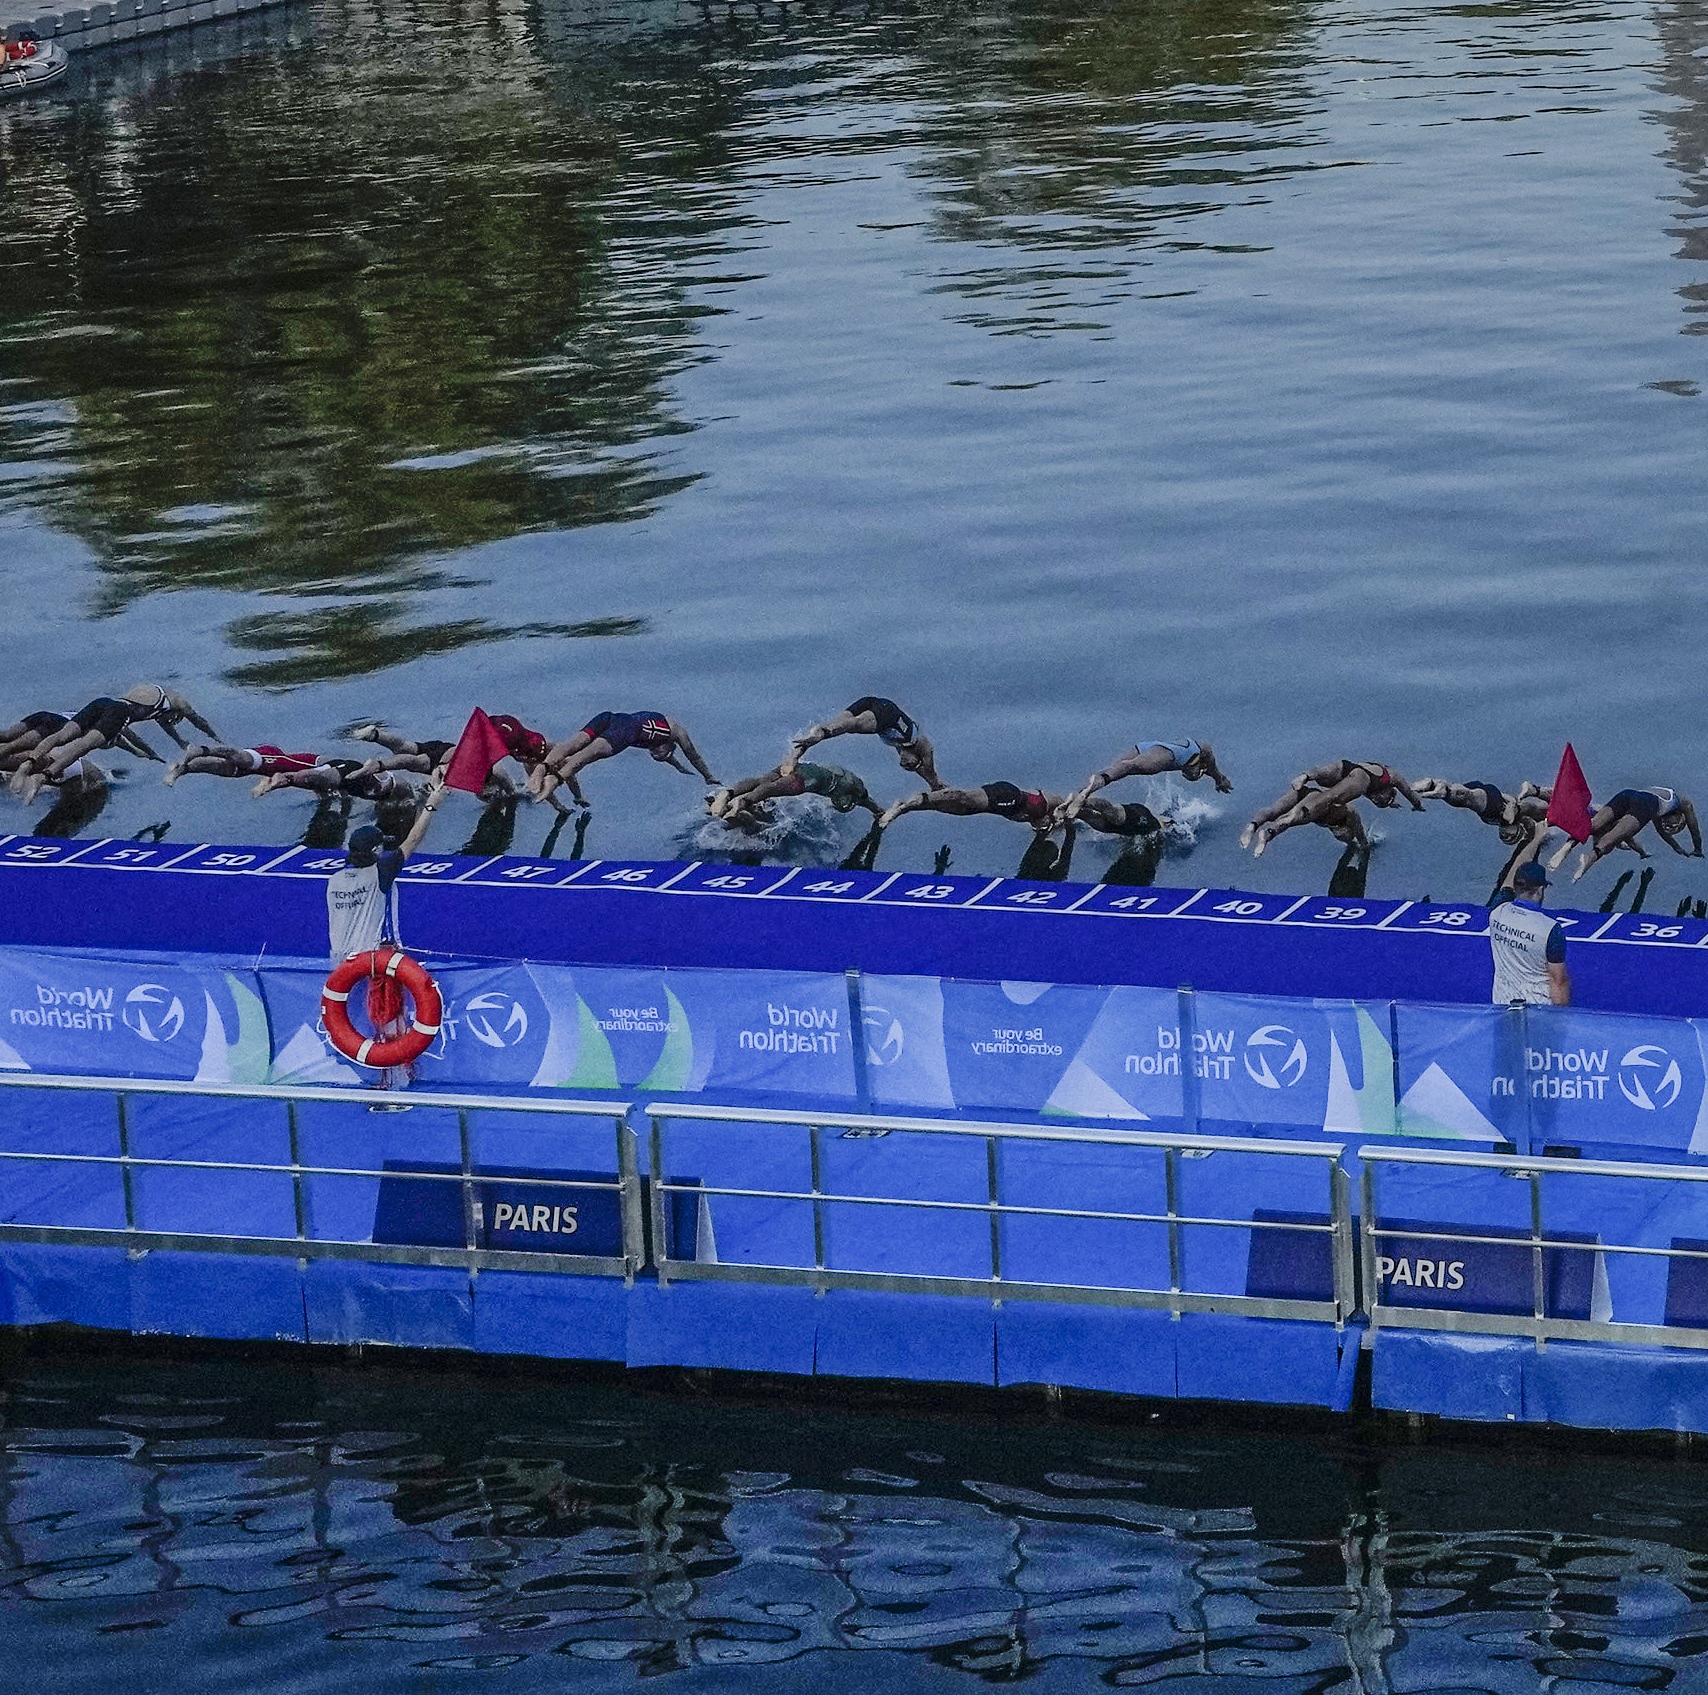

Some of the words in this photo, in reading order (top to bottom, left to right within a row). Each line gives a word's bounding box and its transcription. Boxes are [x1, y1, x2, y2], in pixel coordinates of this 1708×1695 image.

[5, 844, 62, 859] 52
[103, 849, 158, 862] 51
[200, 853, 256, 866] 50
[401, 862, 454, 875] 48
[500, 865, 557, 879] 47
[600, 868, 654, 882] 46
[701, 875, 755, 889] 45
[802, 880, 855, 894] 44
[904, 884, 955, 899] 43
[1006, 890, 1058, 904] 42
[1109, 896, 1159, 910] 41
[1212, 900, 1263, 915] 40
[1313, 906, 1367, 920] 39
[1418, 911, 1472, 926] 38
[1555, 916, 1580, 929] 7
[1493, 919, 1536, 942] TECHNICAL
[1630, 923, 1684, 938] 36
[1494, 933, 1529, 952] OFFICIAL
[493, 1203, 579, 1234] PARIS
[1376, 1256, 1466, 1290] PARIS
